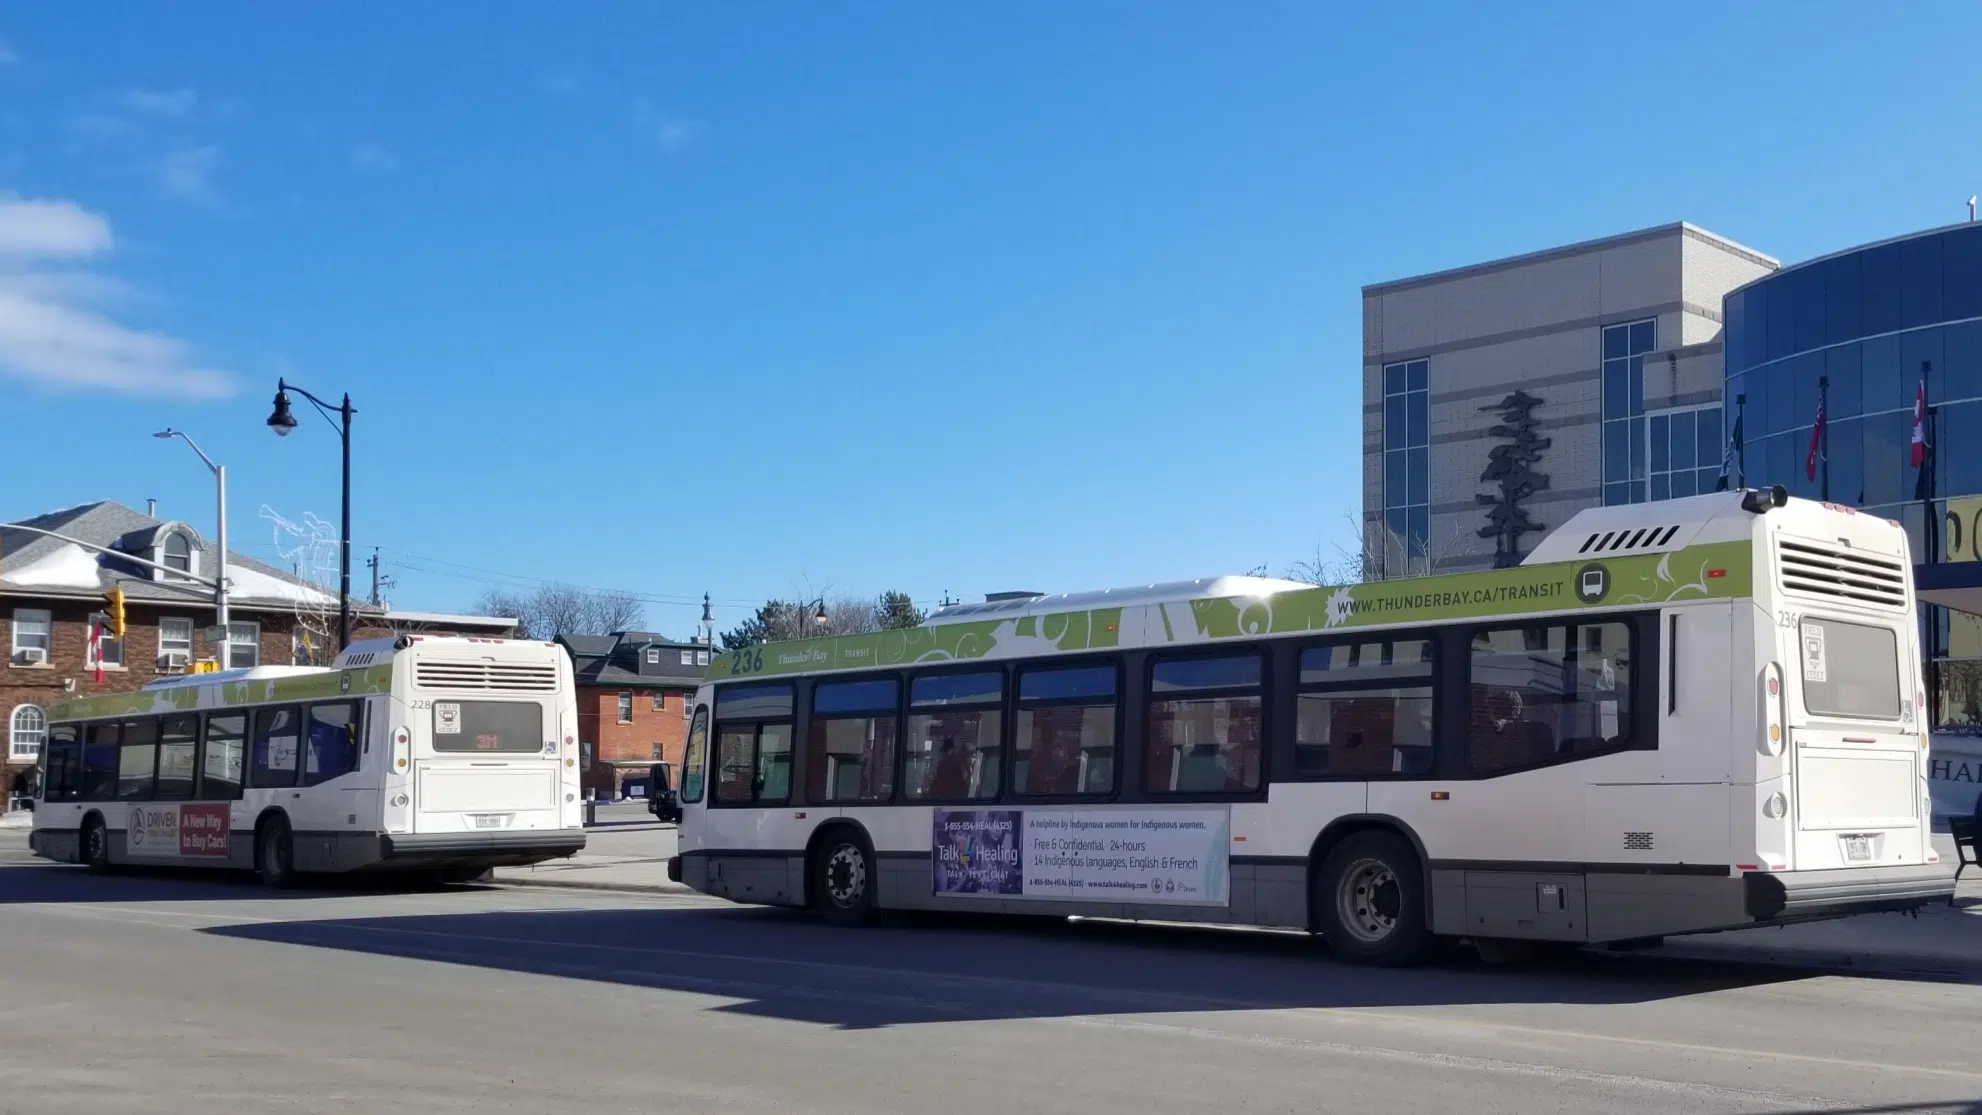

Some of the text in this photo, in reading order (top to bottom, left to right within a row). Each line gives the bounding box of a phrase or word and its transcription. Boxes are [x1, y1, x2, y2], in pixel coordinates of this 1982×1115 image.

[1337, 581, 1564, 615] WWW.THUNDERBAY.CA/TRANSIT
[1778, 610, 1797, 629] 236
[731, 648, 763, 675] 236
[778, 650, 828, 665] Thunder Bay
[844, 648, 869, 658] TRANSIT
[411, 700, 431, 710] 228
[147, 811, 176, 828] DRIVEN
[182, 813, 222, 832] A New Way
[944, 819, 1013, 832] 1-855-554-HEAL (4325)
[1030, 819, 1206, 832] A helpline by Indigenous women for Indigenous women.
[183, 834, 190, 848] to
[192, 833, 206, 852] Buy
[207, 833, 227, 849] Cars!
[1034, 837, 1146, 852] Free & Confidential 24-hours
[938, 844, 959, 861] Talk
[976, 843, 1018, 866] Healing
[1034, 854, 1198, 872] 14 Indigenous languages, English & French
[947, 870, 1009, 882] TALK TEXT CHAT
